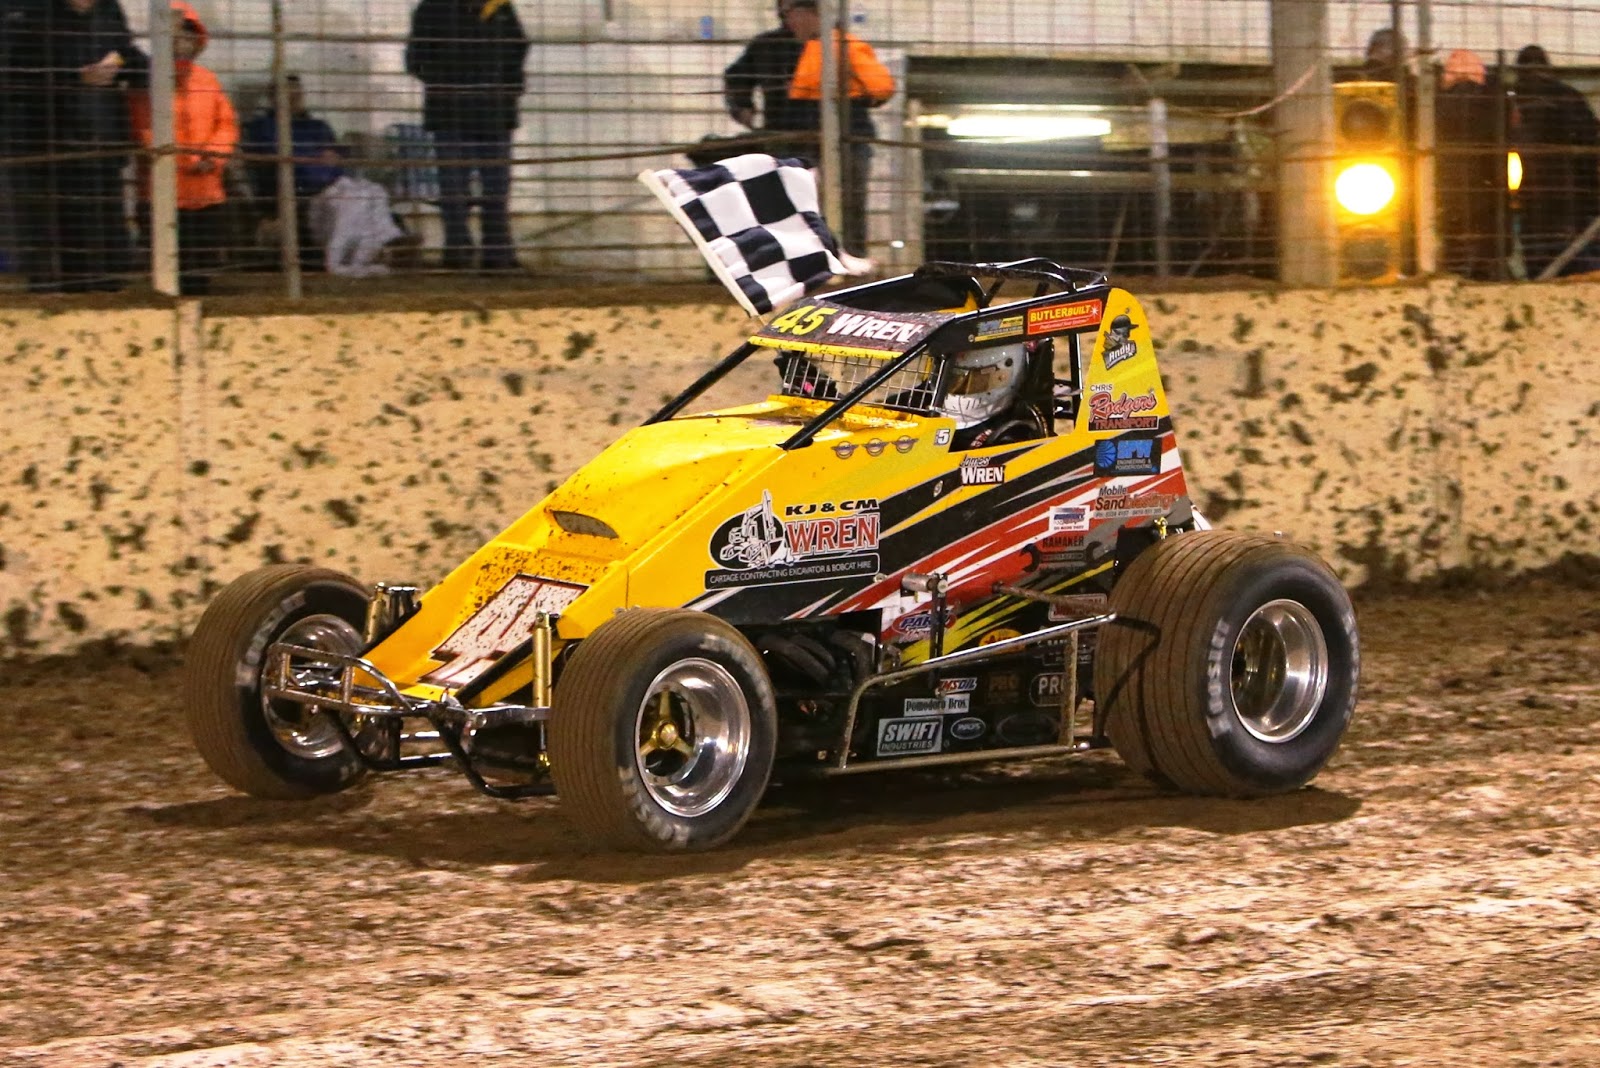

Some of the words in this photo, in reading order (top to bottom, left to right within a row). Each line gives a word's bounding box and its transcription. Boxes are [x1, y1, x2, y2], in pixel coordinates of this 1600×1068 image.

[1030, 305, 1091, 322] BUTLERBUILT
[771, 305, 838, 335] 45
[827, 313, 925, 343] WREN
[1109, 343, 1131, 362] Andy
[1090, 383, 1113, 391] CHRIS
[1089, 391, 1157, 422] Rodgers
[1094, 417, 1157, 430] TRANSPORT
[960, 454, 991, 468] James
[961, 466, 1004, 484] WREN
[1099, 484, 1127, 496] Mobile
[785, 505, 815, 516] KJ
[820, 503, 835, 512] &
[839, 499, 879, 511] CM
[786, 515, 880, 556] WREN
[710, 574, 739, 584] CARTAGE
[739, 569, 788, 582] CONTRACTING
[788, 565, 825, 577] EXCAVATOR
[825, 565, 831, 573] &
[831, 562, 857, 572] BOBCAT
[857, 560, 871, 569] HIRE
[906, 699, 946, 712] Pomodoro
[948, 697, 967, 709] Bros.
[884, 722, 939, 742] SWIFT
[881, 740, 933, 751] INDUSTRIES
